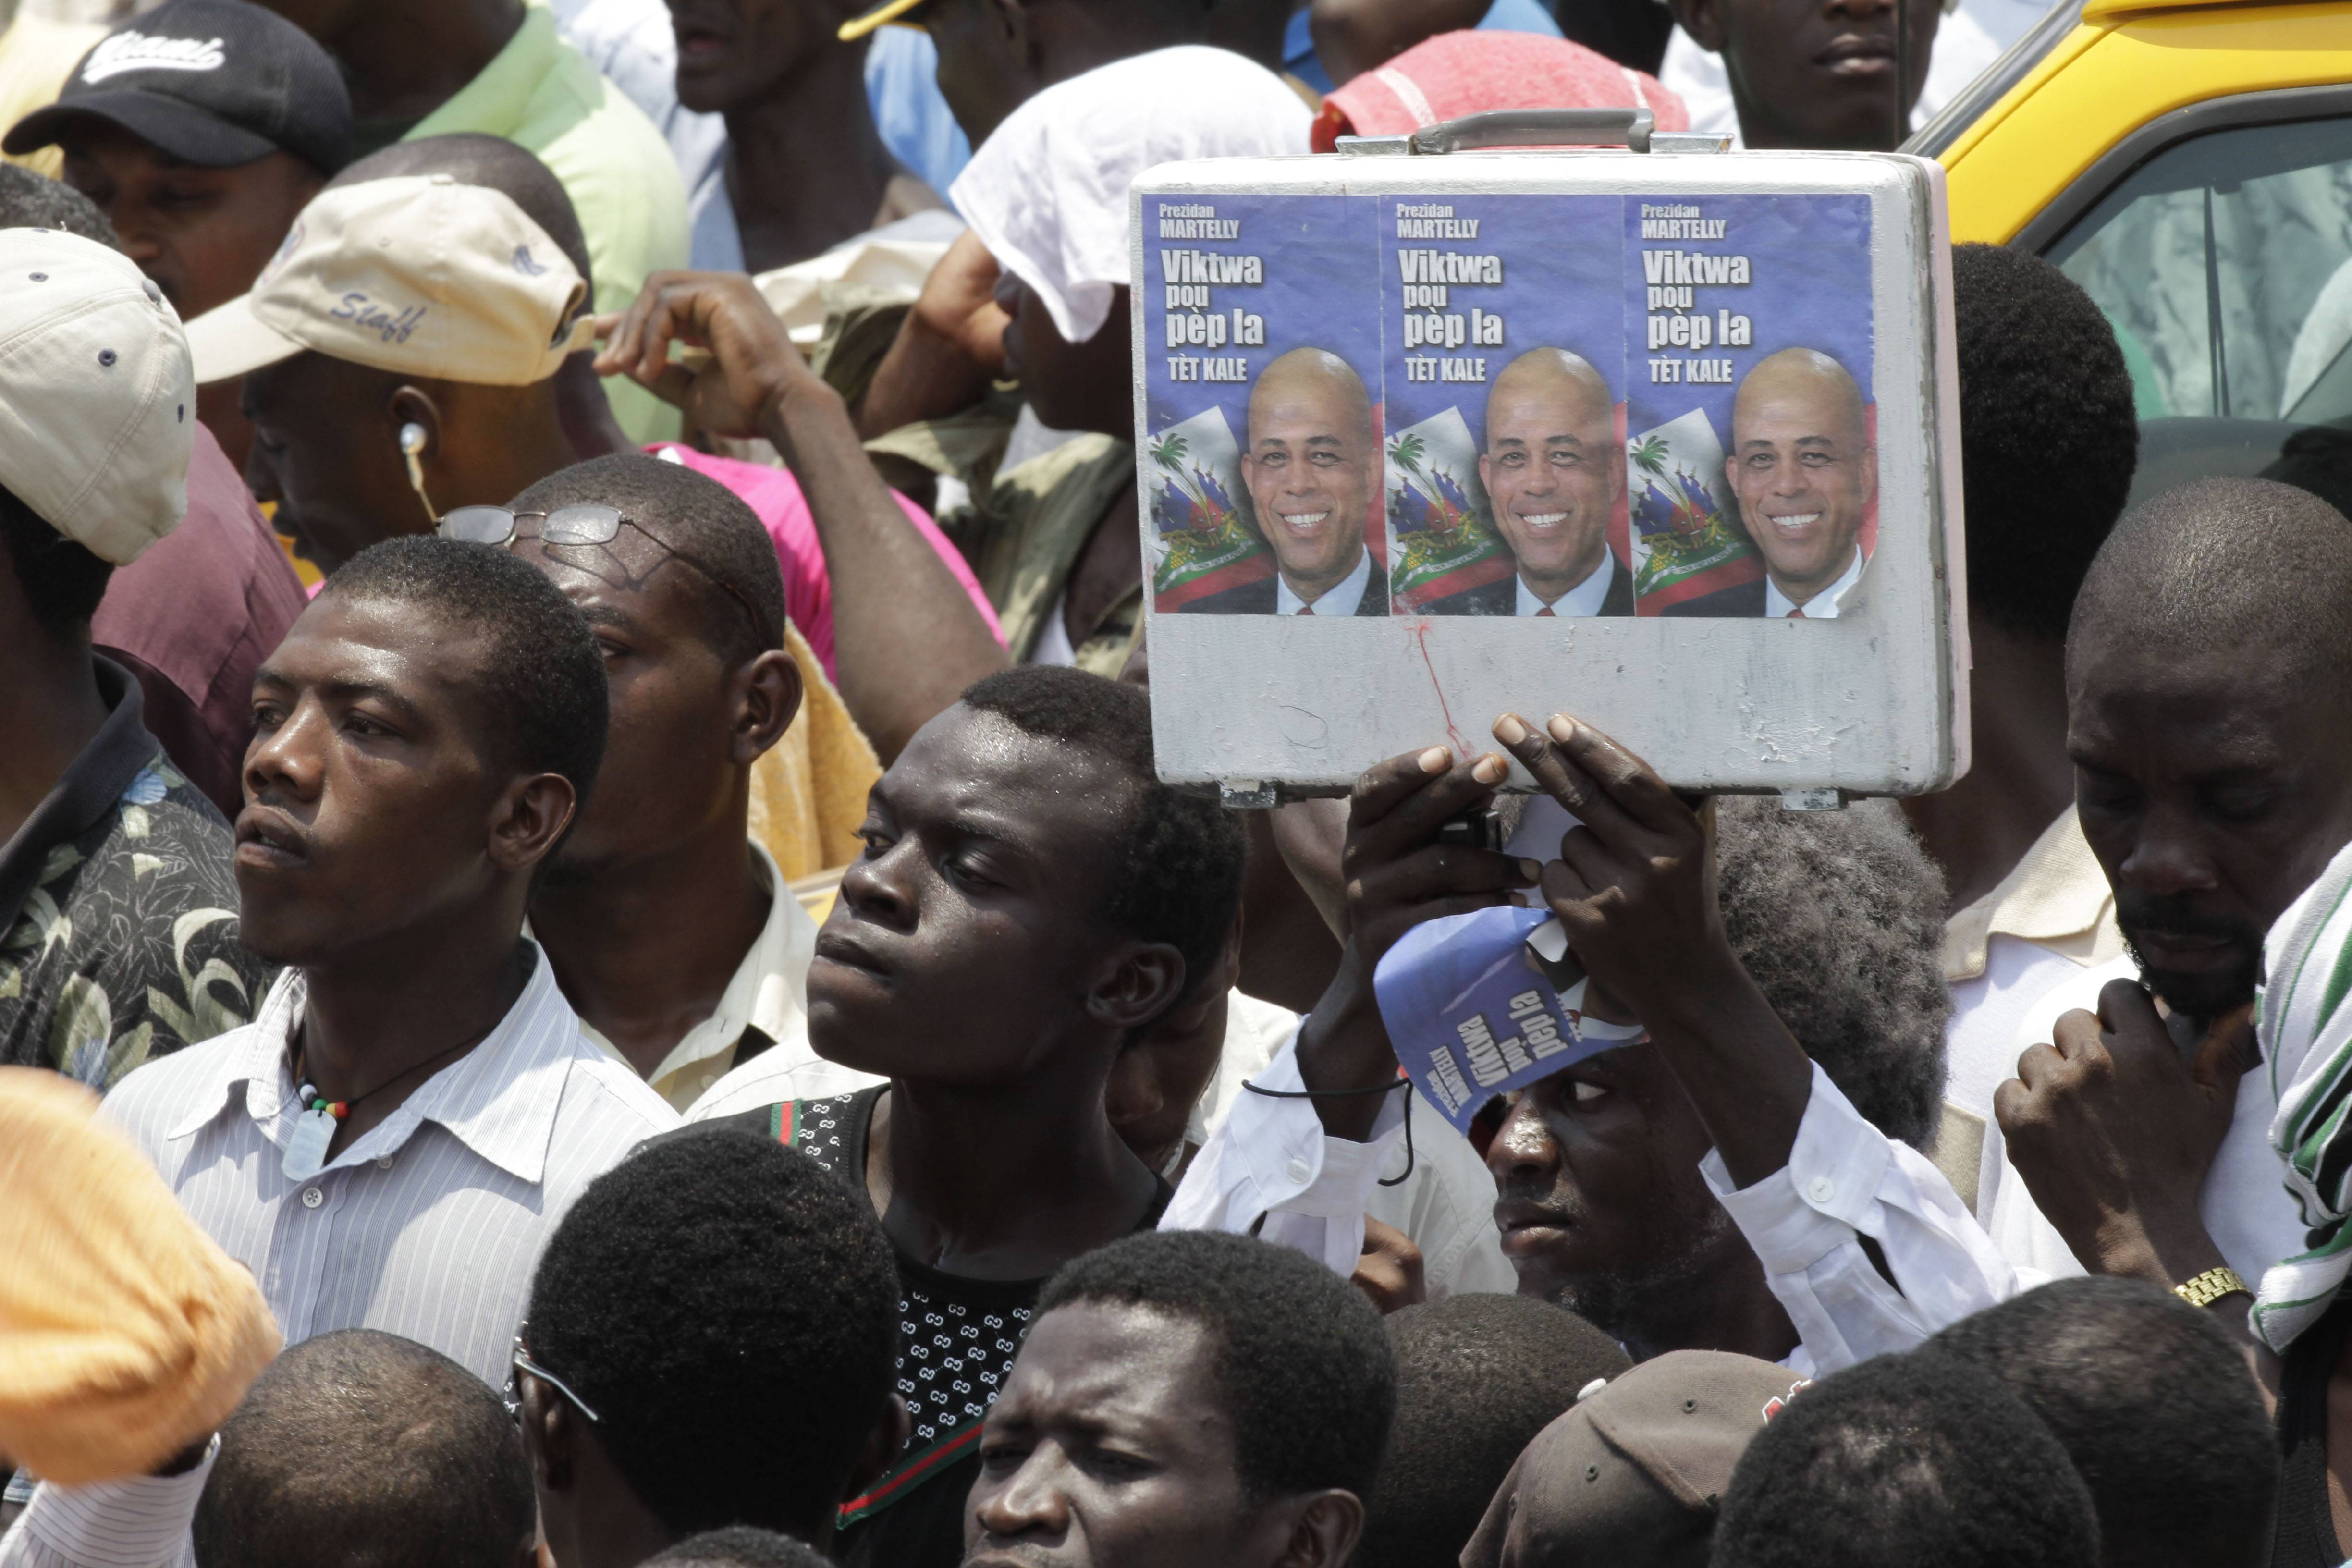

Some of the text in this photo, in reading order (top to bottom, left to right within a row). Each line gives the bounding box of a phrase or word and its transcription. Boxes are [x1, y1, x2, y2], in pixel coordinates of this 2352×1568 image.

[1159, 203, 1214, 218] Prezidan
[1396, 203, 1453, 218] Prezidan
[1641, 204, 1699, 218] Prezidan
[1160, 219, 1240, 239] MARTELLY
[1397, 219, 1479, 239] MARTELLY
[1642, 219, 1727, 239] MARTELLY
[1161, 249, 1262, 283] Viktwa
[1398, 249, 1502, 283] Viktwa
[1642, 250, 1750, 284] Viktwa
[1165, 284, 1209, 309] pou
[1403, 284, 1447, 309] pou
[1647, 286, 1693, 310] pou
[331, 293, 425, 343] Staff
[1166, 306, 1264, 347] pèp la
[1404, 306, 1503, 348] pèp la
[1648, 307, 1751, 349] pèp la
[1167, 353, 1248, 381] TÈT KALE
[1404, 354, 1486, 381] TÈT KALE
[1648, 355, 1733, 382] TÈT KALE
[1508, 990, 1544, 1020] la
[1457, 1014, 1511, 1088] Viktwa
[1499, 1036, 1534, 1073] pou
[1429, 1045, 1473, 1107] MARTELLY
